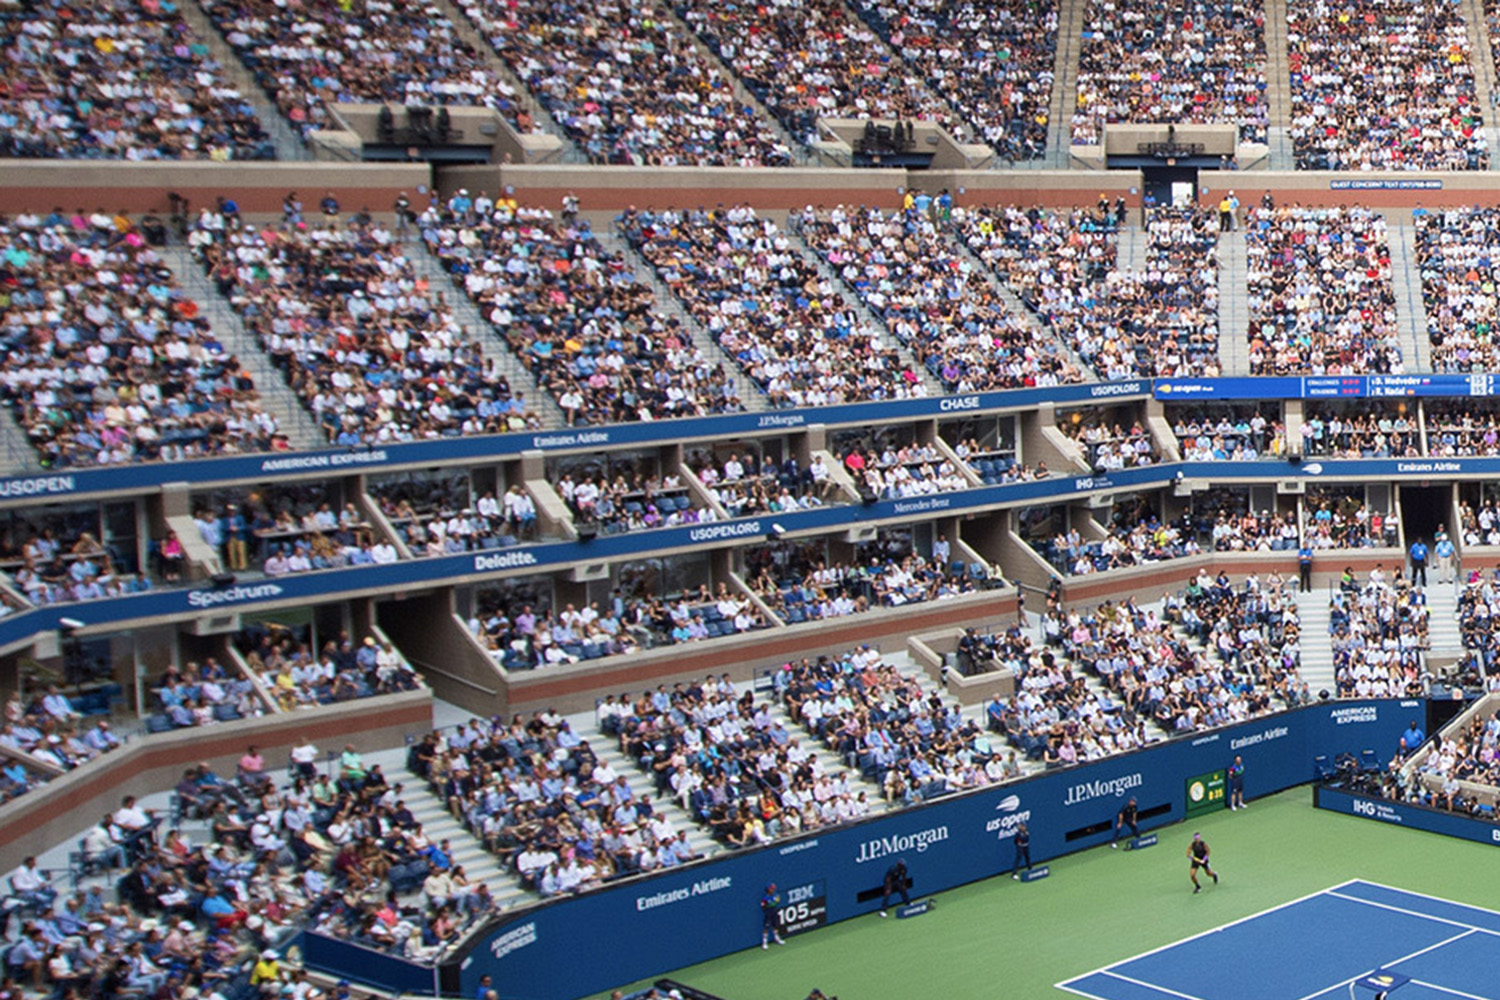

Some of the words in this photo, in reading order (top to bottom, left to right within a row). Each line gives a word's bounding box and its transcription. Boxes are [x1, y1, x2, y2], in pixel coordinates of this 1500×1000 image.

[1091, 383, 1140, 396] USOPEN.ORG
[940, 396, 979, 411] CHASE
[533, 434, 575, 448] Emirates
[577, 431, 608, 445] Airline
[262, 455, 327, 472] AMERICAN
[330, 450, 386, 467] EXPRESS
[1398, 462, 1431, 472] Emirates
[1433, 461, 1461, 472] Airline
[1076, 478, 1093, 490] IHG
[894, 498, 950, 514] Mercedes-Benz
[690, 521, 760, 541] USOPEN.ORG
[475, 551, 537, 570] Deloitte.
[188, 583, 273, 608] Spectrum
[1330, 706, 1376, 718] AMERICAN
[1337, 714, 1377, 724] EXPRESS
[1230, 734, 1262, 750] Emirates
[1264, 727, 1288, 741] Airline
[1064, 772, 1142, 805] J.P.Morgan
[1353, 800, 1375, 815] IHG
[986, 818, 1000, 831] us
[1001, 810, 1031, 828] open
[855, 825, 948, 862] J.P.Morgan
[637, 886, 689, 910] Emirates
[691, 876, 731, 895] Airline
[788, 884, 814, 904] IBM
[777, 902, 808, 925] 105
[490, 922, 536, 951] AMERICAN
[495, 932, 537, 958] EXPRESS
